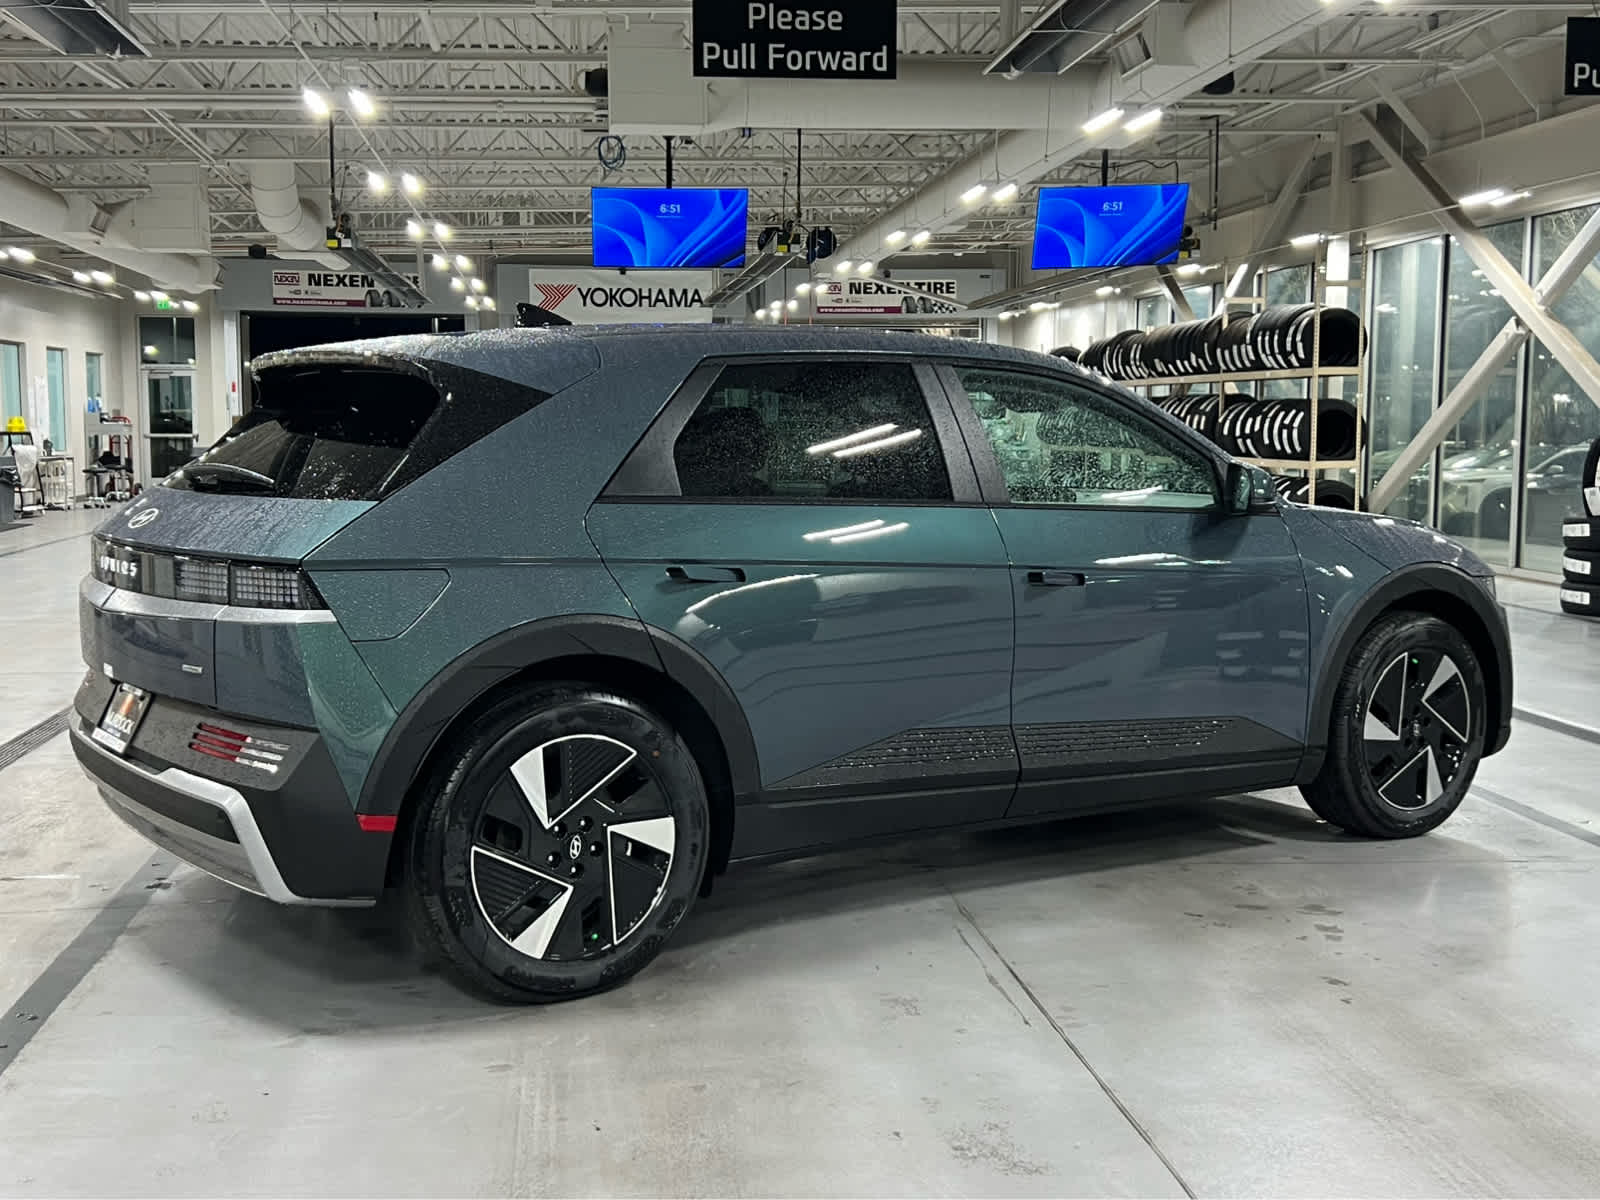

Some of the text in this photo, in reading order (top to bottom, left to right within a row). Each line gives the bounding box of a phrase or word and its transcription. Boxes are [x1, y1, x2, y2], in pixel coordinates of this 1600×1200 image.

[748, 2, 844, 31] Please
[703, 42, 888, 72] Pull Forward
[660, 203, 681, 214] 6:51
[1103, 201, 1123, 211] 6:51
[307, 273, 375, 287] NEXEN
[914, 281, 956, 295] TIRE
[577, 287, 704, 308] YOKOHAMA
